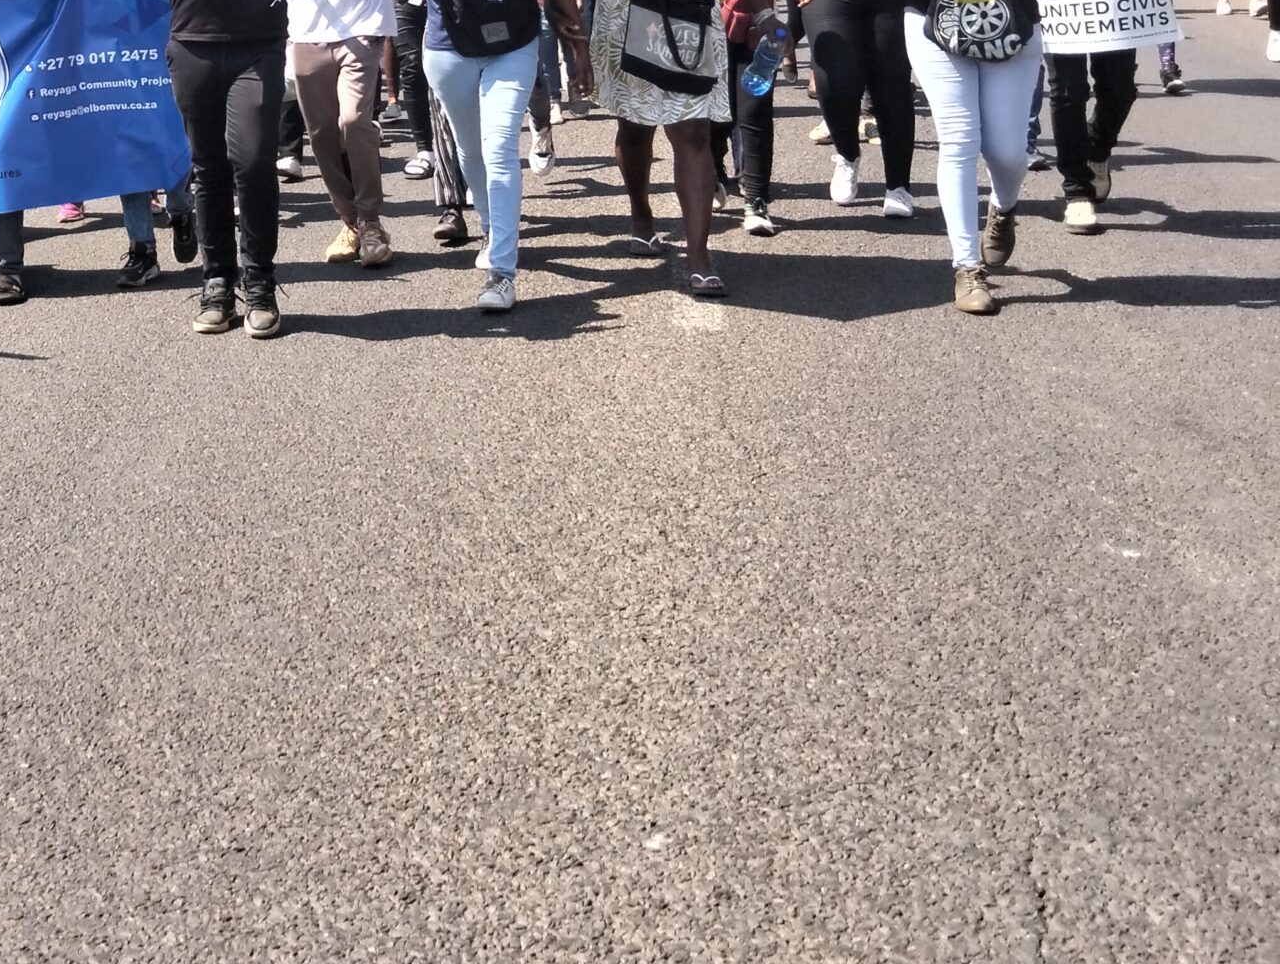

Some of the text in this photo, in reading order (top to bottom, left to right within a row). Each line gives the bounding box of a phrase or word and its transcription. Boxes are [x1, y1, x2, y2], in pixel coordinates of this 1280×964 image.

[1040, 0, 1110, 19] UNITED
[1040, 11, 1170, 36] MOVEMENTS
[967, 33, 1023, 59] ANC
[38, 48, 159, 71] +27 79 017 2475
[40, 85, 77, 97] Reyaga
[79, 78, 138, 91] Community
[43, 101, 158, 121] reyaga@elbomvu.co.za
